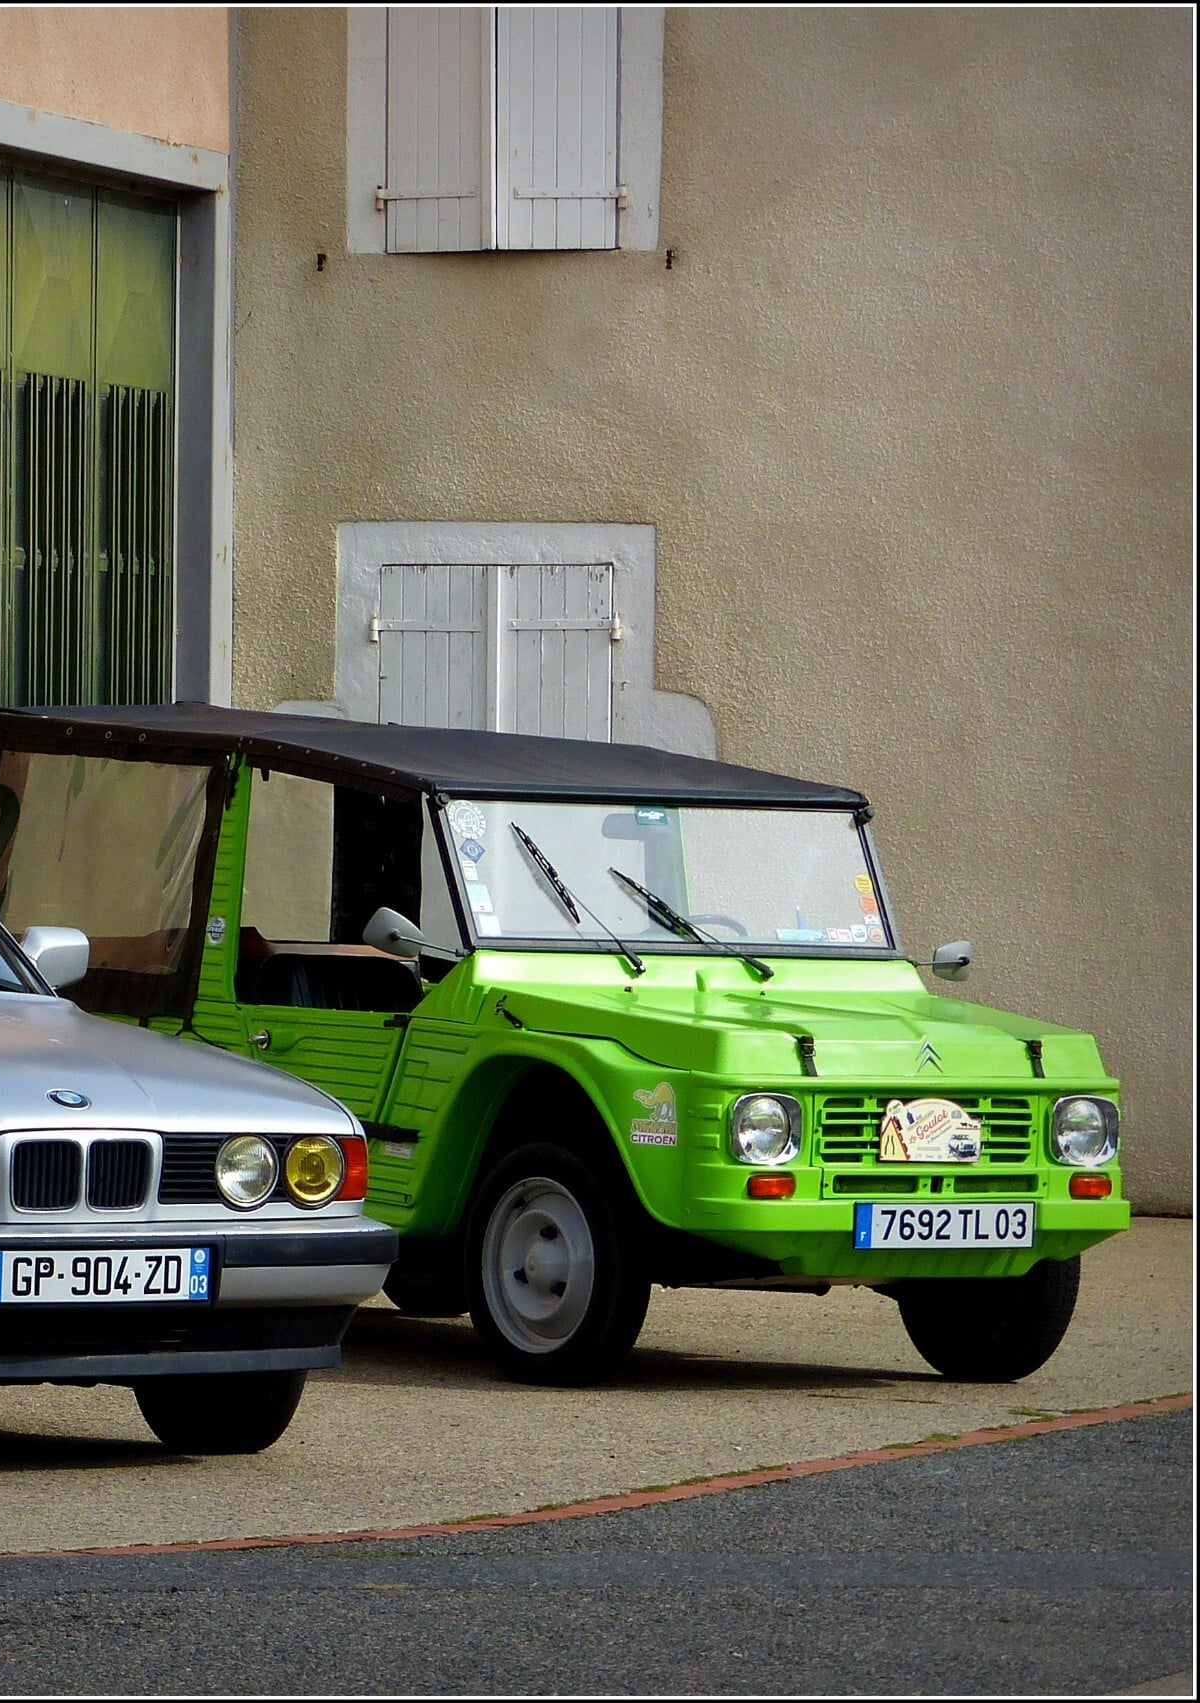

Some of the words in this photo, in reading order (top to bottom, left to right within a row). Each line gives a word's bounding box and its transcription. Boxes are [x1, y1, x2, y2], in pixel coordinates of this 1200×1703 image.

[860, 1231, 867, 1241] F
[880, 1209, 952, 1241] 7692
[958, 1209, 990, 1241] TL
[995, 1208, 1027, 1240] 03
[11, 1255, 182, 1297] GP-904-ZD
[190, 1274, 207, 1294] 03
